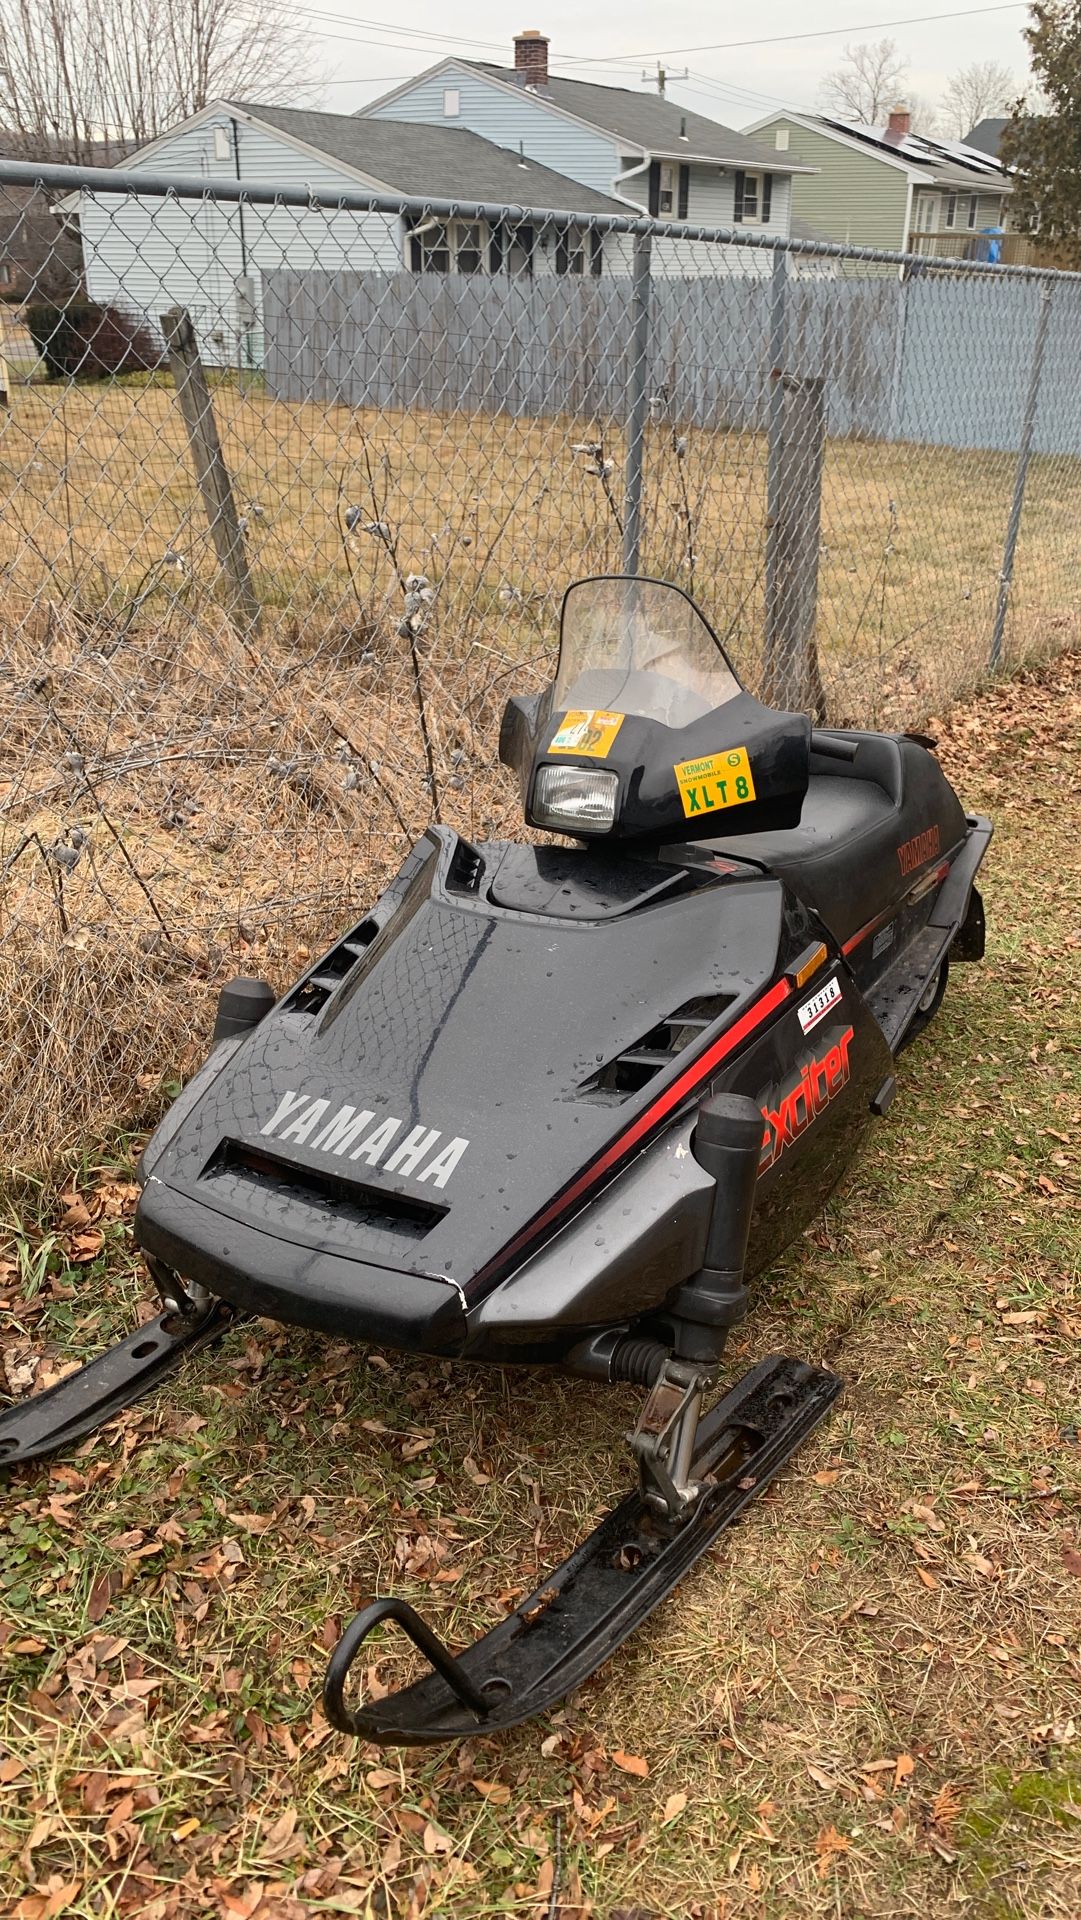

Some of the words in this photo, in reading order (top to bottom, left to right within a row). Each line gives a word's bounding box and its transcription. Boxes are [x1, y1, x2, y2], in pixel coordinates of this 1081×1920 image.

[680, 770, 721, 784] SNOWMOBILE
[682, 760, 714, 776] VERMONT
[897, 824, 939, 876] YAMAHA
[807, 987, 835, 1018] 31318
[259, 1091, 470, 1189] YAMAHA
